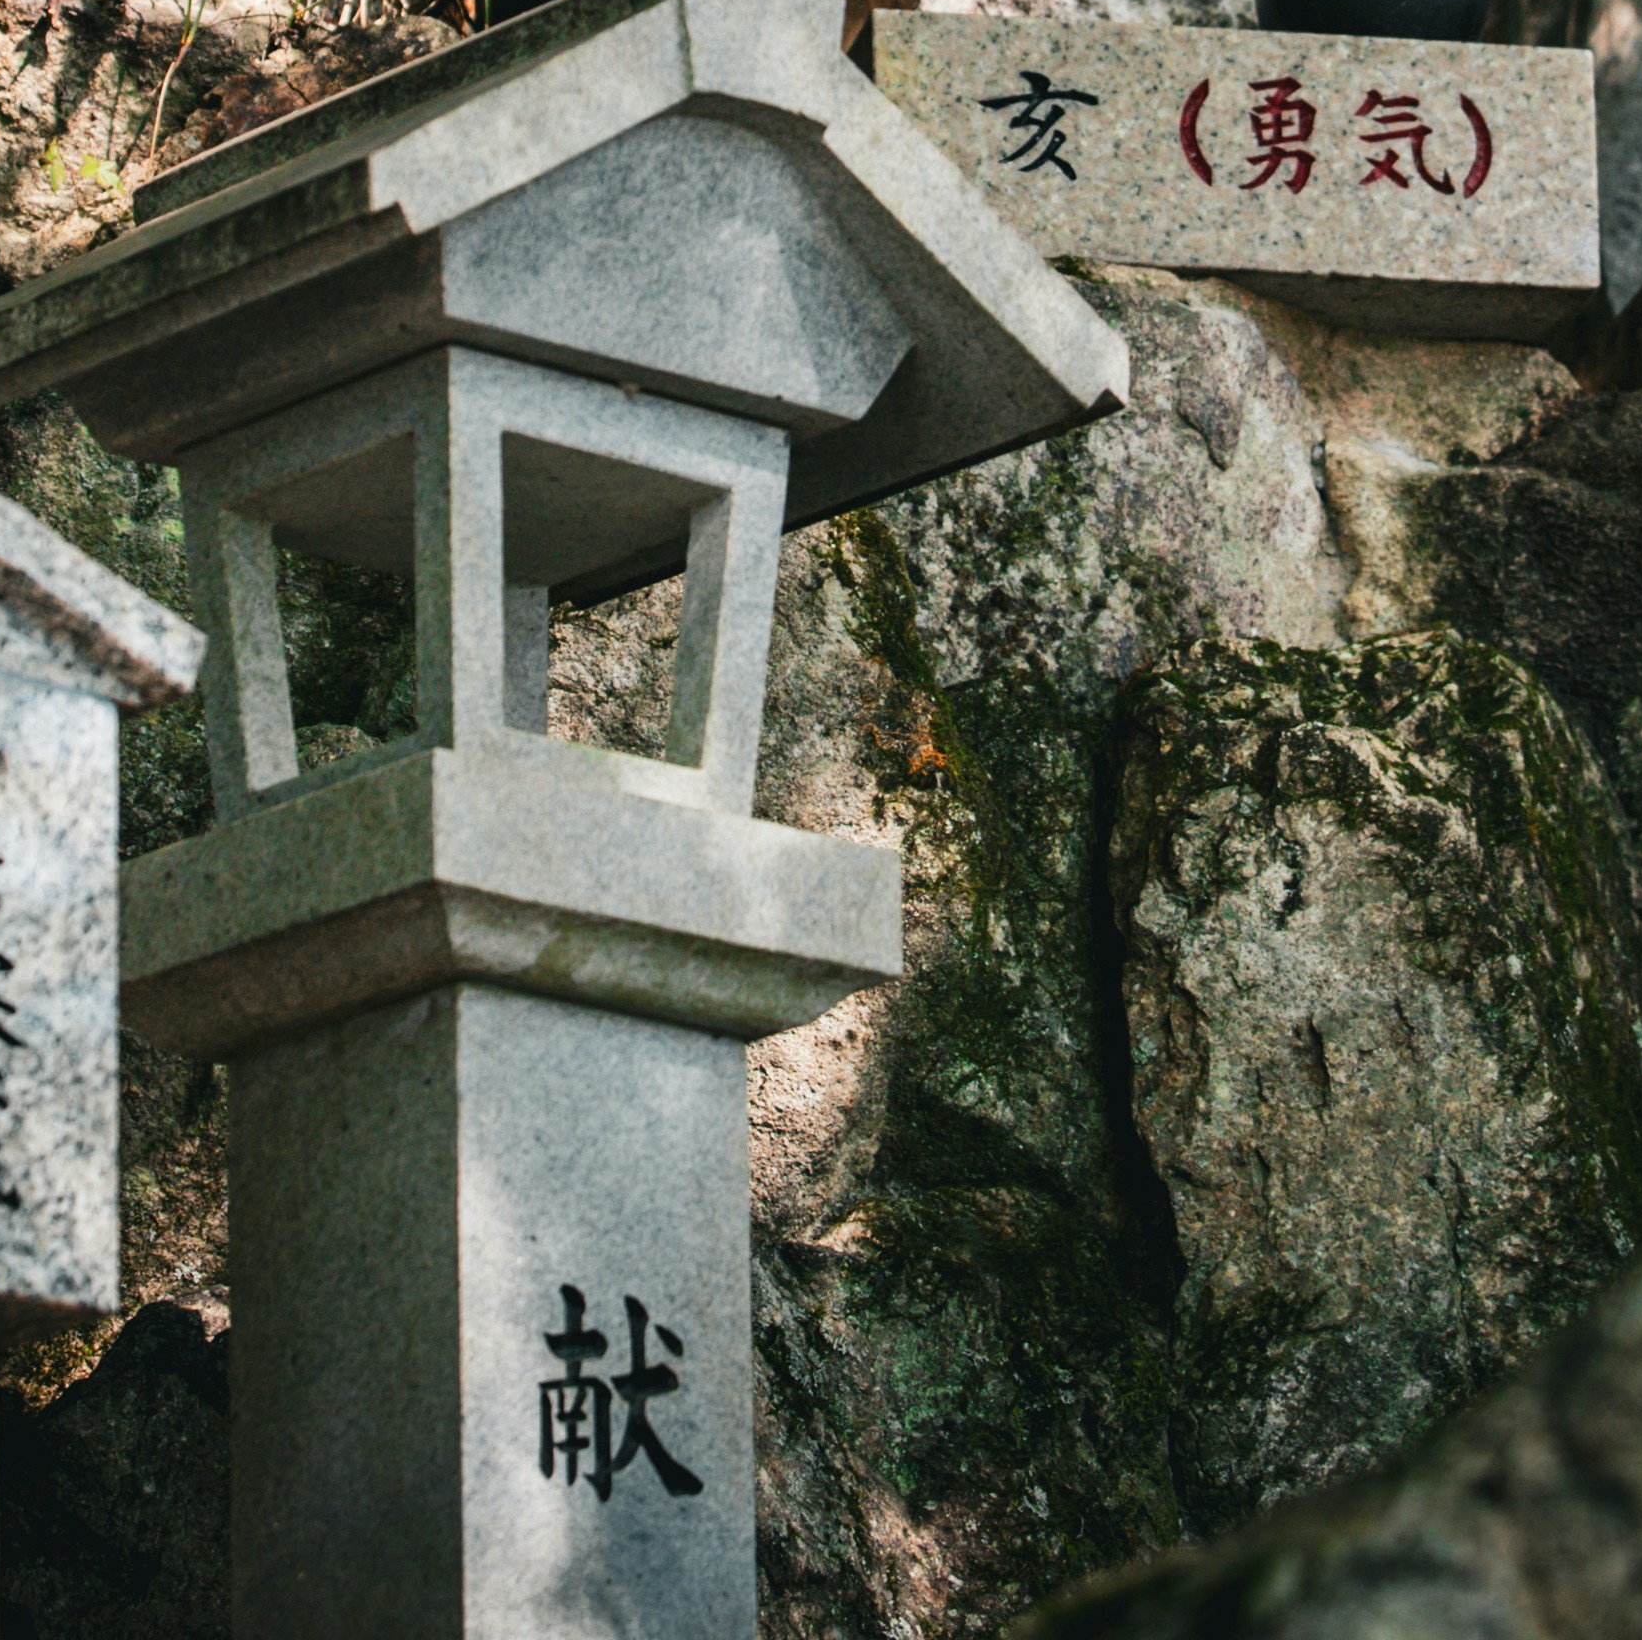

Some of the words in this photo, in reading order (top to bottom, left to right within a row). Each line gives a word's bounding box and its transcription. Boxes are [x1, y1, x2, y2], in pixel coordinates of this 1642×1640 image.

[979, 70, 1099, 182] 亥
[1179, 76, 1494, 199] (勇気)
[538, 1283, 705, 1504] 献
